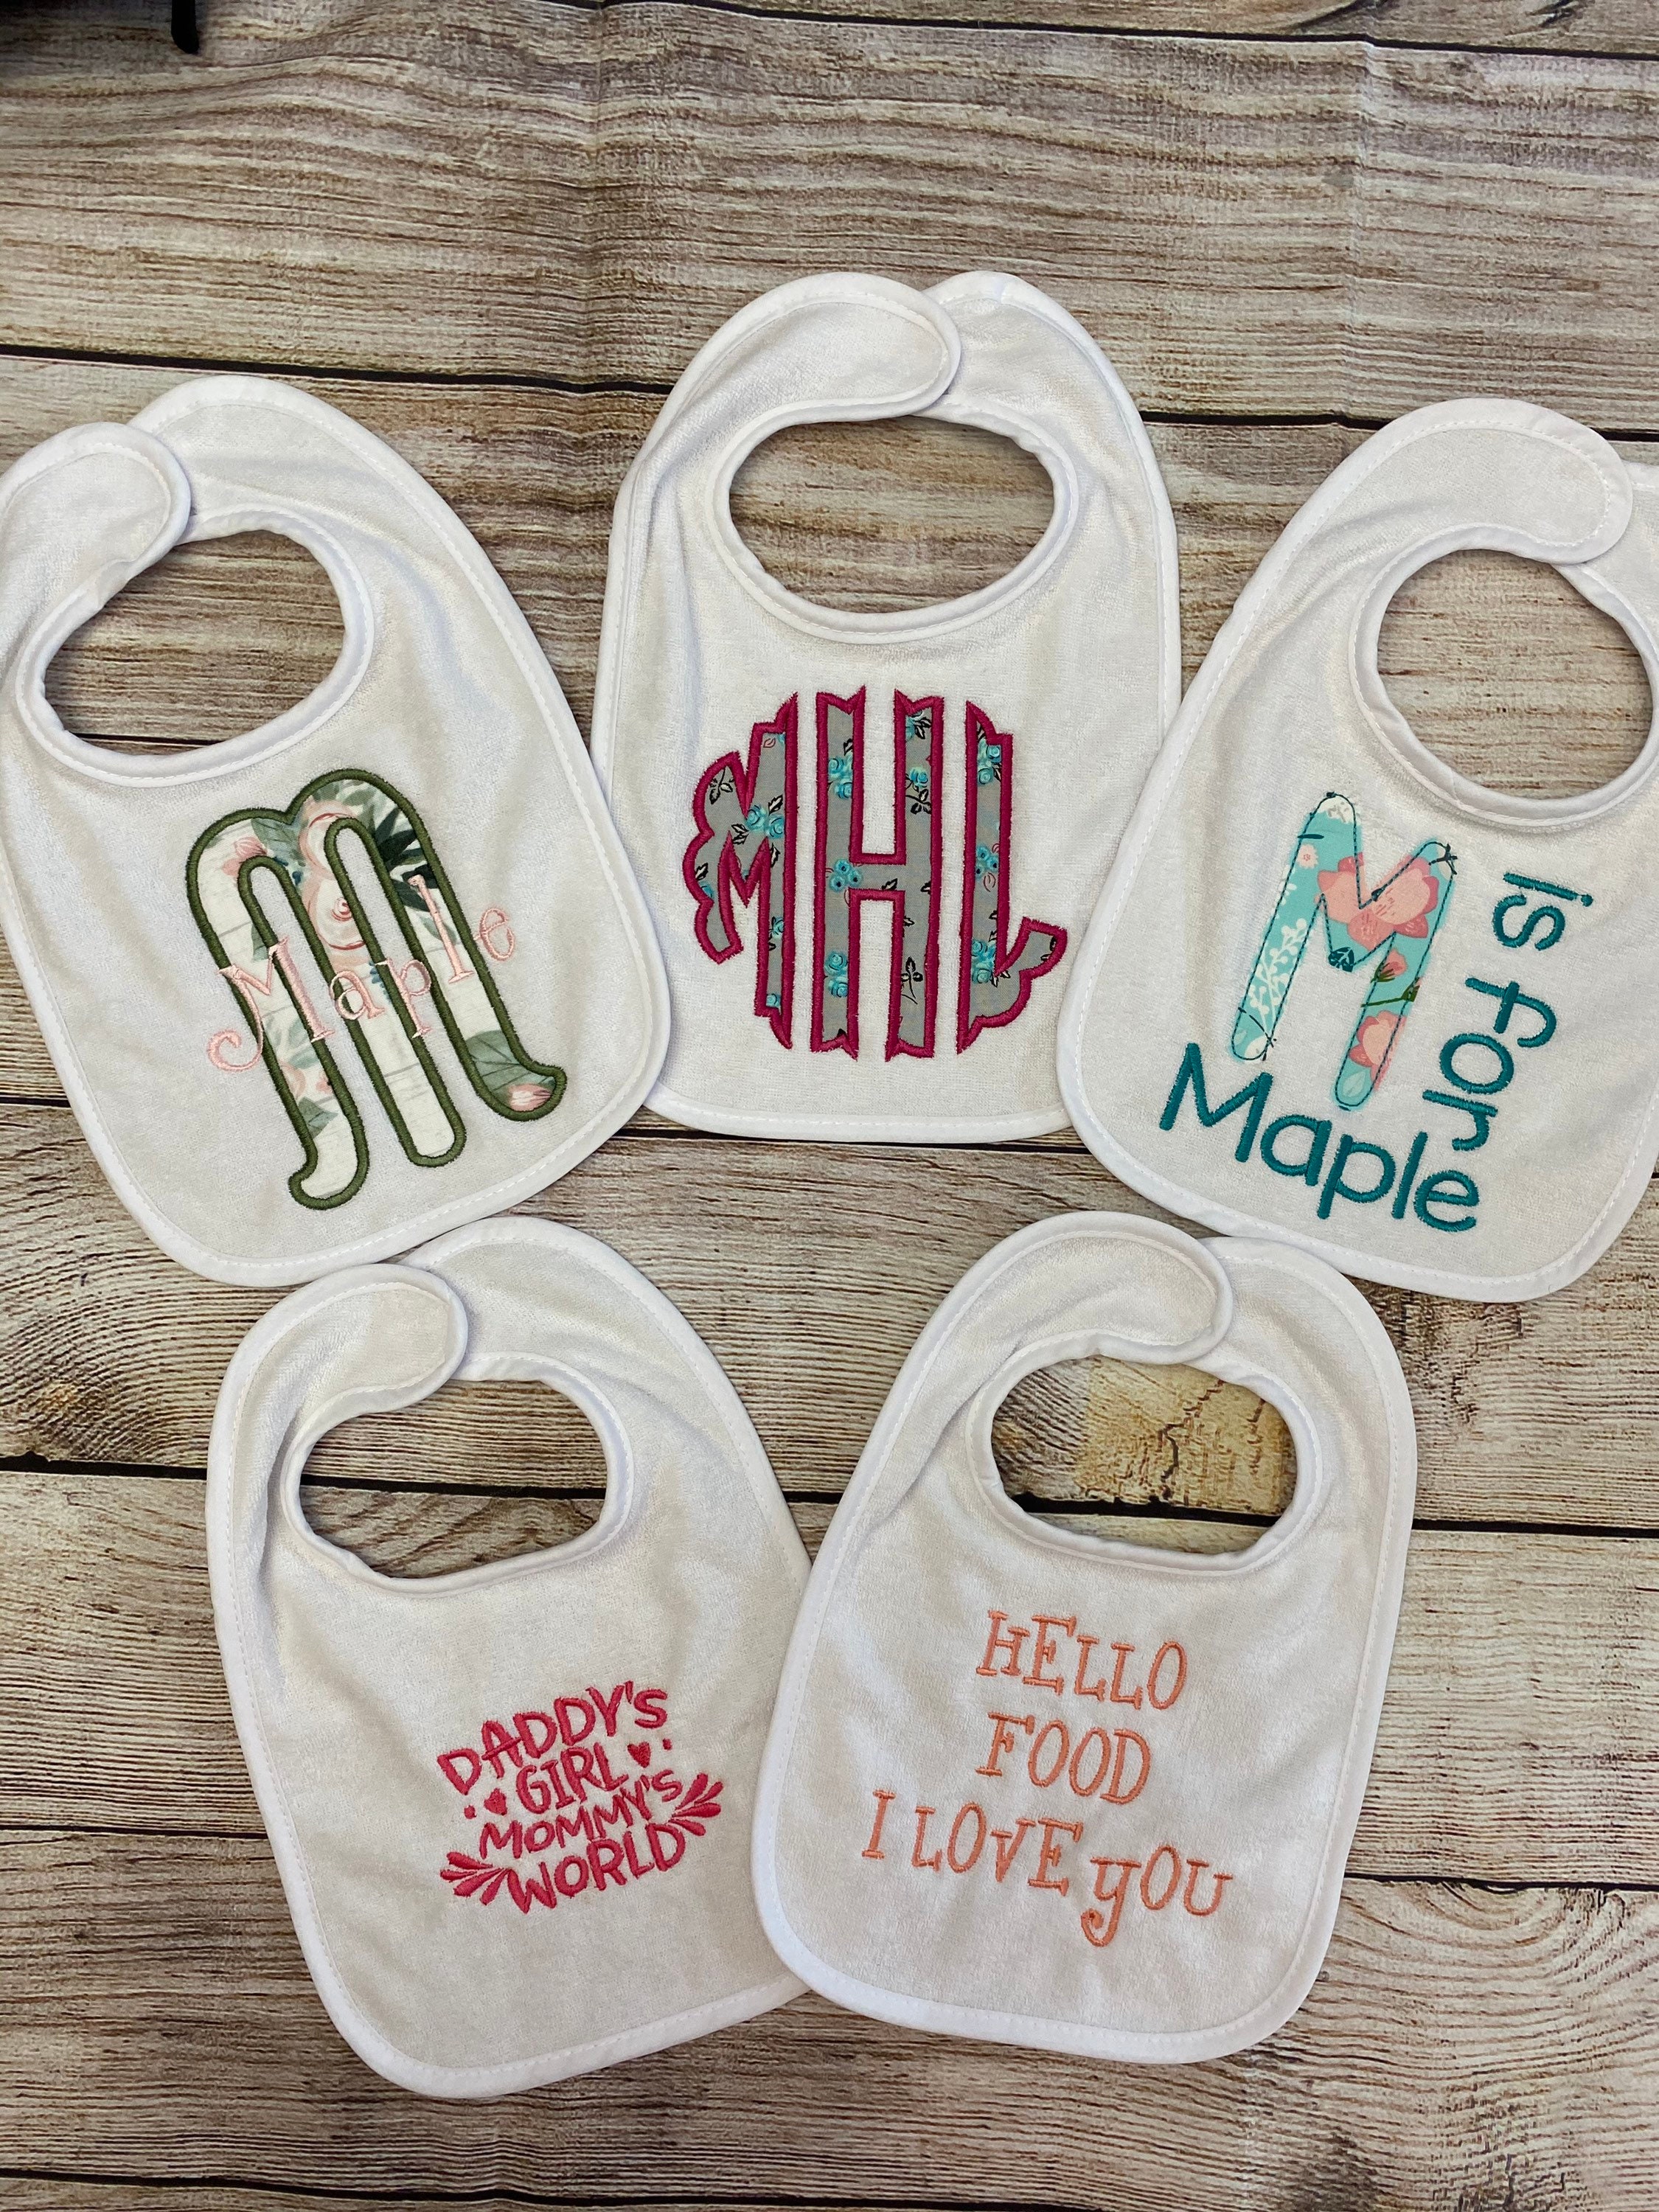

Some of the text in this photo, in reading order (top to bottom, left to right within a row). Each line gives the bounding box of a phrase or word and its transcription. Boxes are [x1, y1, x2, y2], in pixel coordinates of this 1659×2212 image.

[186, 768, 567, 1210] M
[206, 874, 516, 1072] Maple
[1230, 792, 1458, 1111] M
[1422, 872, 1593, 1151] is for
[1158, 1043, 1480, 1231] Maple
[975, 1610, 1187, 1710] HELLO
[437, 1680, 668, 1795] DADDY'S
[516, 1742, 629, 1814] GIRL
[975, 1711, 1151, 1805] FOOD
[479, 1770, 683, 1860] MOMMY'S
[506, 1822, 686, 1914] WORLD
[861, 1788, 896, 1860] I
[911, 1801, 1084, 1896] LOVE
